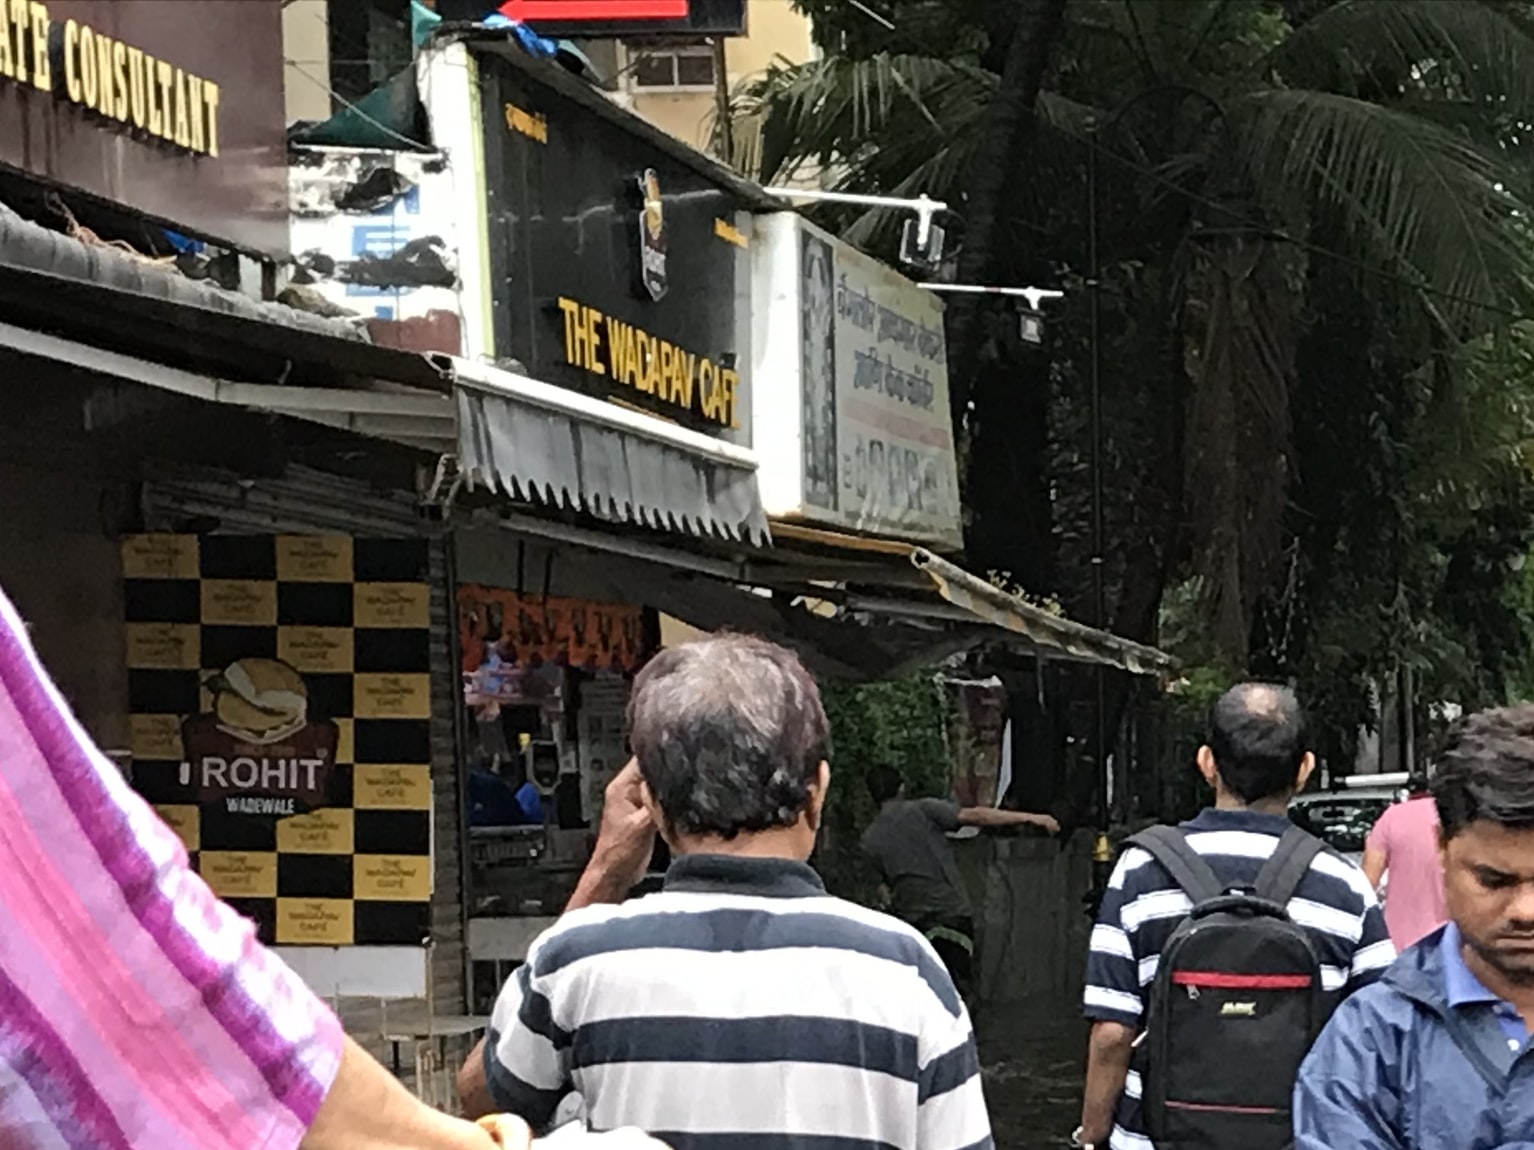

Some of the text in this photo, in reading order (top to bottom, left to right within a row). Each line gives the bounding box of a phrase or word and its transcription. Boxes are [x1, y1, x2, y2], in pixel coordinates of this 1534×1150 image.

[64, 18, 219, 158] CONSULTANT
[558, 296, 605, 375] THE
[606, 316, 696, 410] WADAPAV
[202, 757, 324, 790] ROHIT
